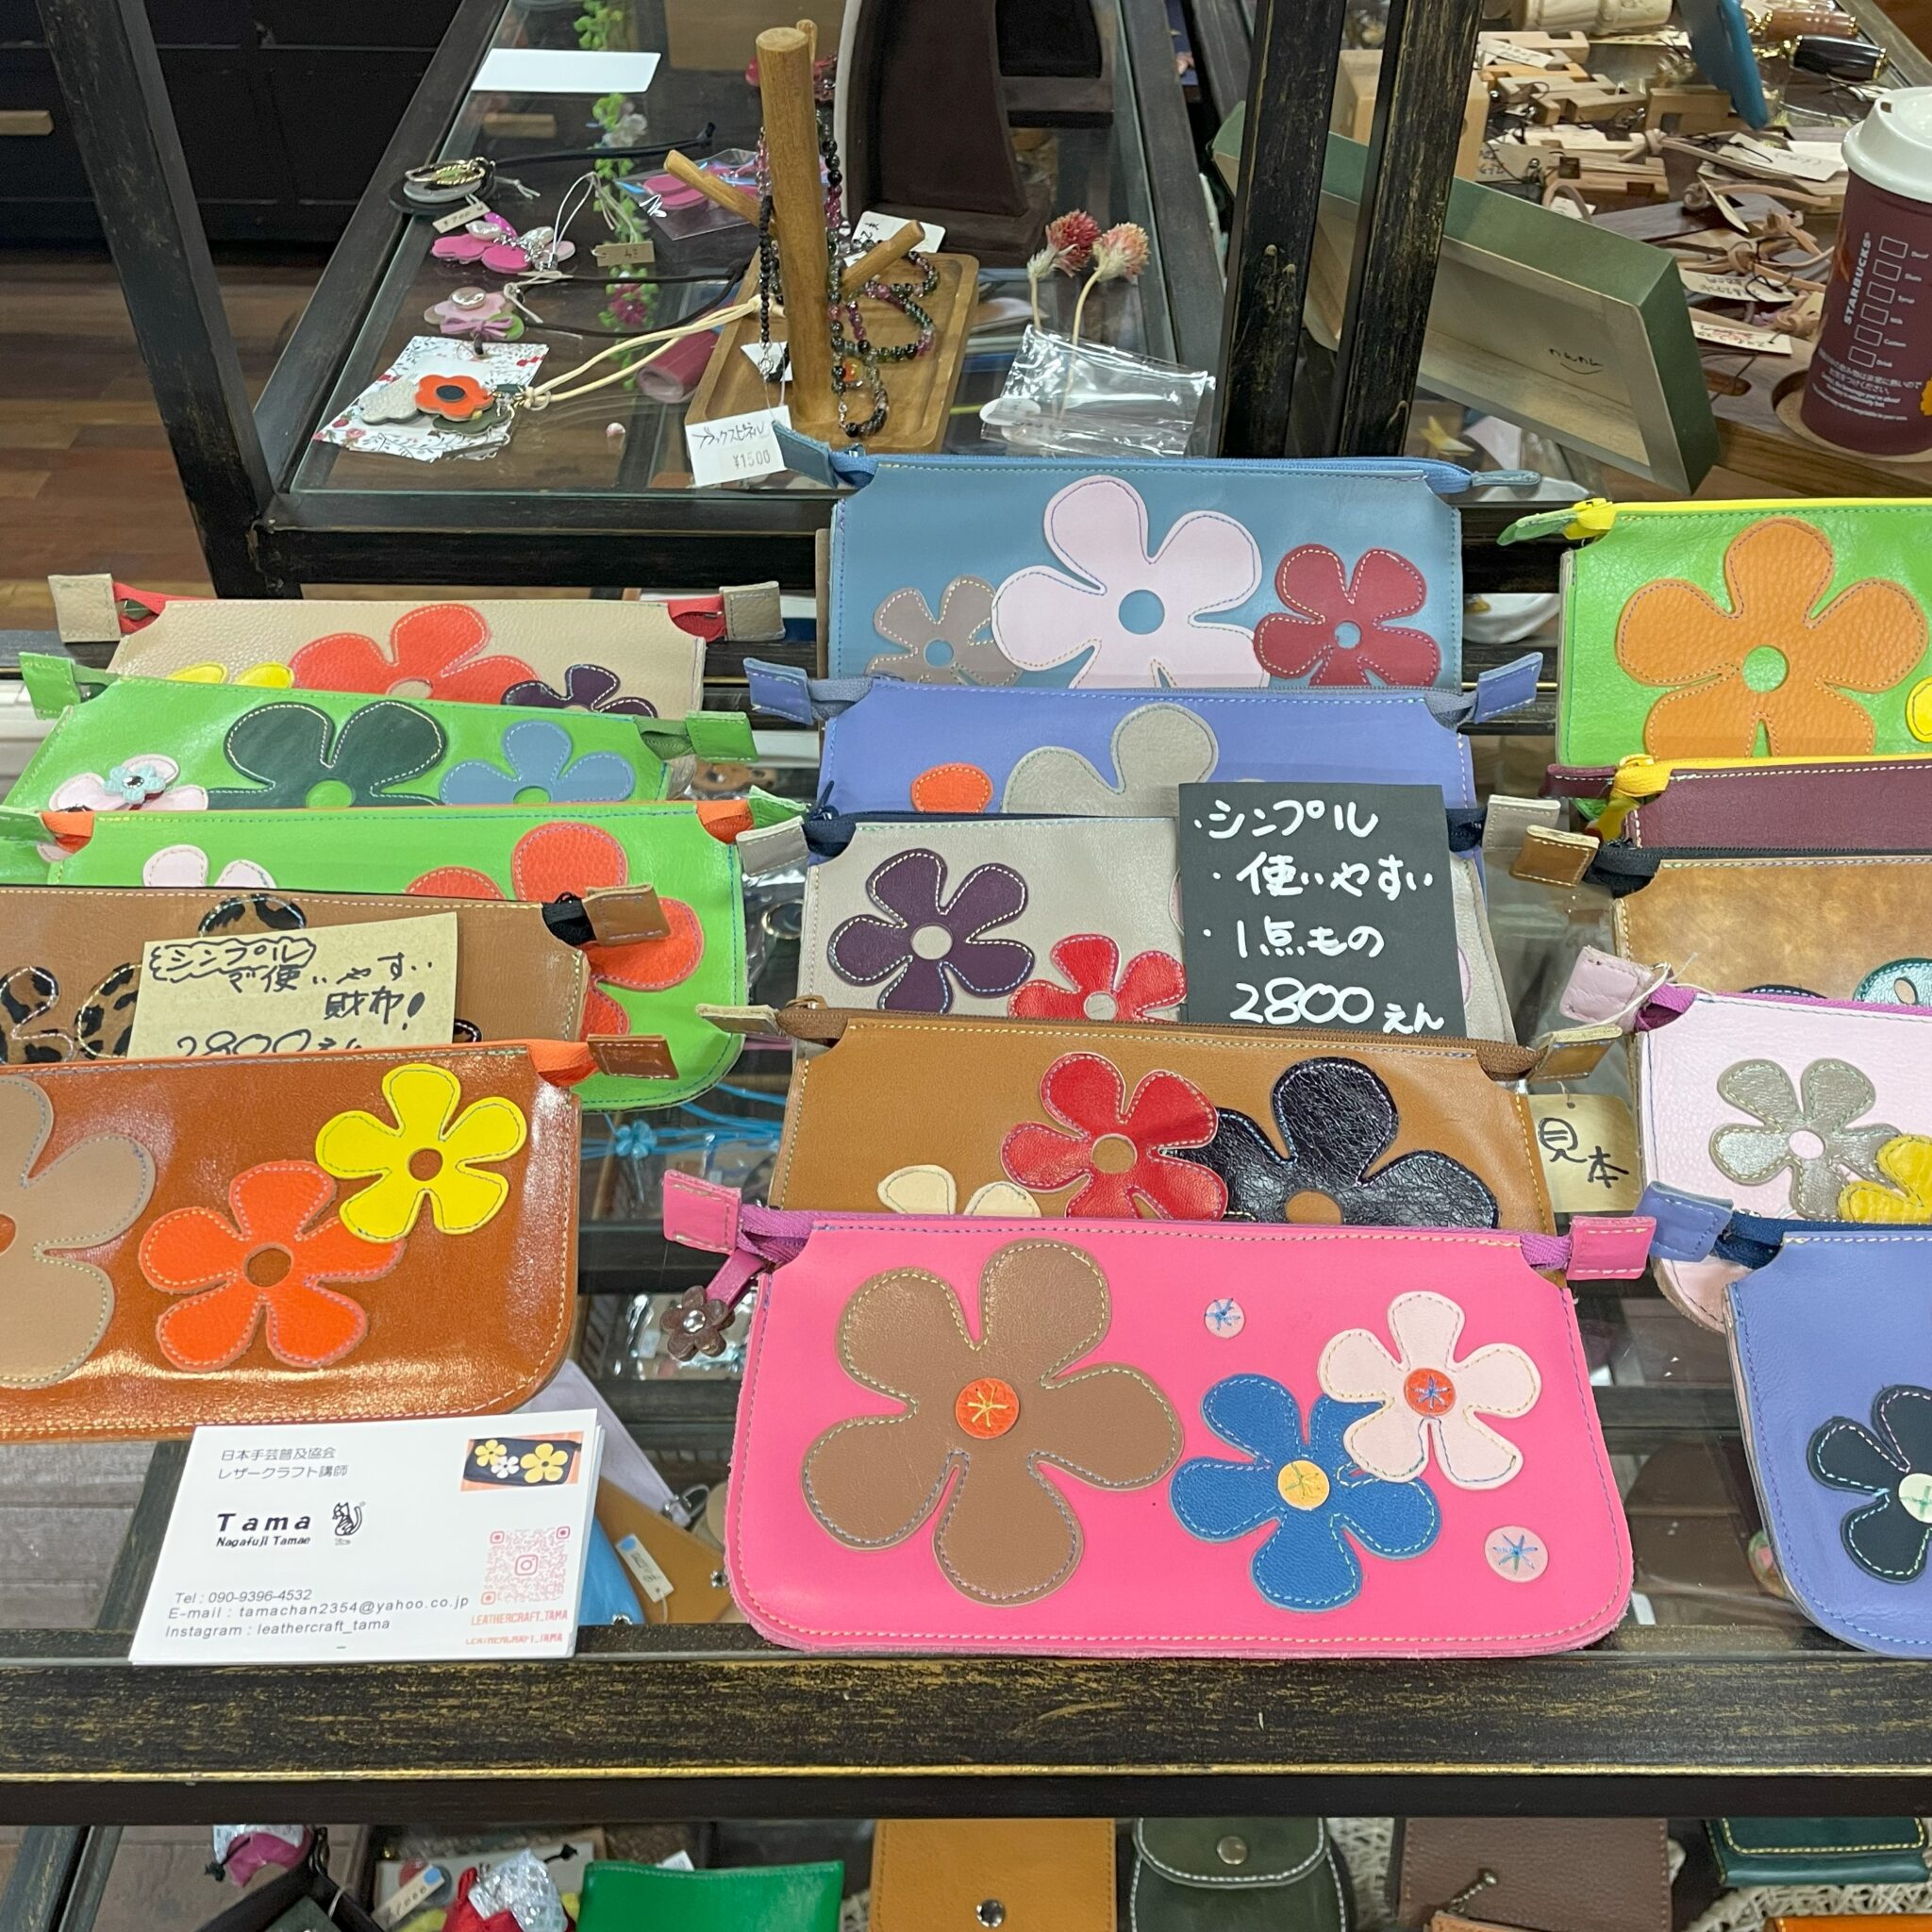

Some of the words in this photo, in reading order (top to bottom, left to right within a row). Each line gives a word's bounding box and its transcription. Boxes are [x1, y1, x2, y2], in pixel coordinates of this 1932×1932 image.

[1843, 238, 1872, 325] STARBUCKS
[732, 449, 771, 470] ¥1500
[165, 944, 310, 972] シンプル
[1538, 1117, 1630, 1190] 見本
[221, 1447, 337, 1461] 日本手芸普及協会
[218, 1464, 348, 1480] レザークラフト講師
[217, 1512, 311, 1533] Tama
[215, 1536, 270, 1548] Nagafuji
[274, 1536, 311, 1546] Tamae
[208, 1589, 313, 1604] 090-9396-4532
[239, 1595, 470, 1618] tamachan2354@yahoo.co.jp
[471, 1609, 569, 1626] LEATHERCRAFT_TAMA
[257, 1620, 391, 1636] leathercraft_tama
